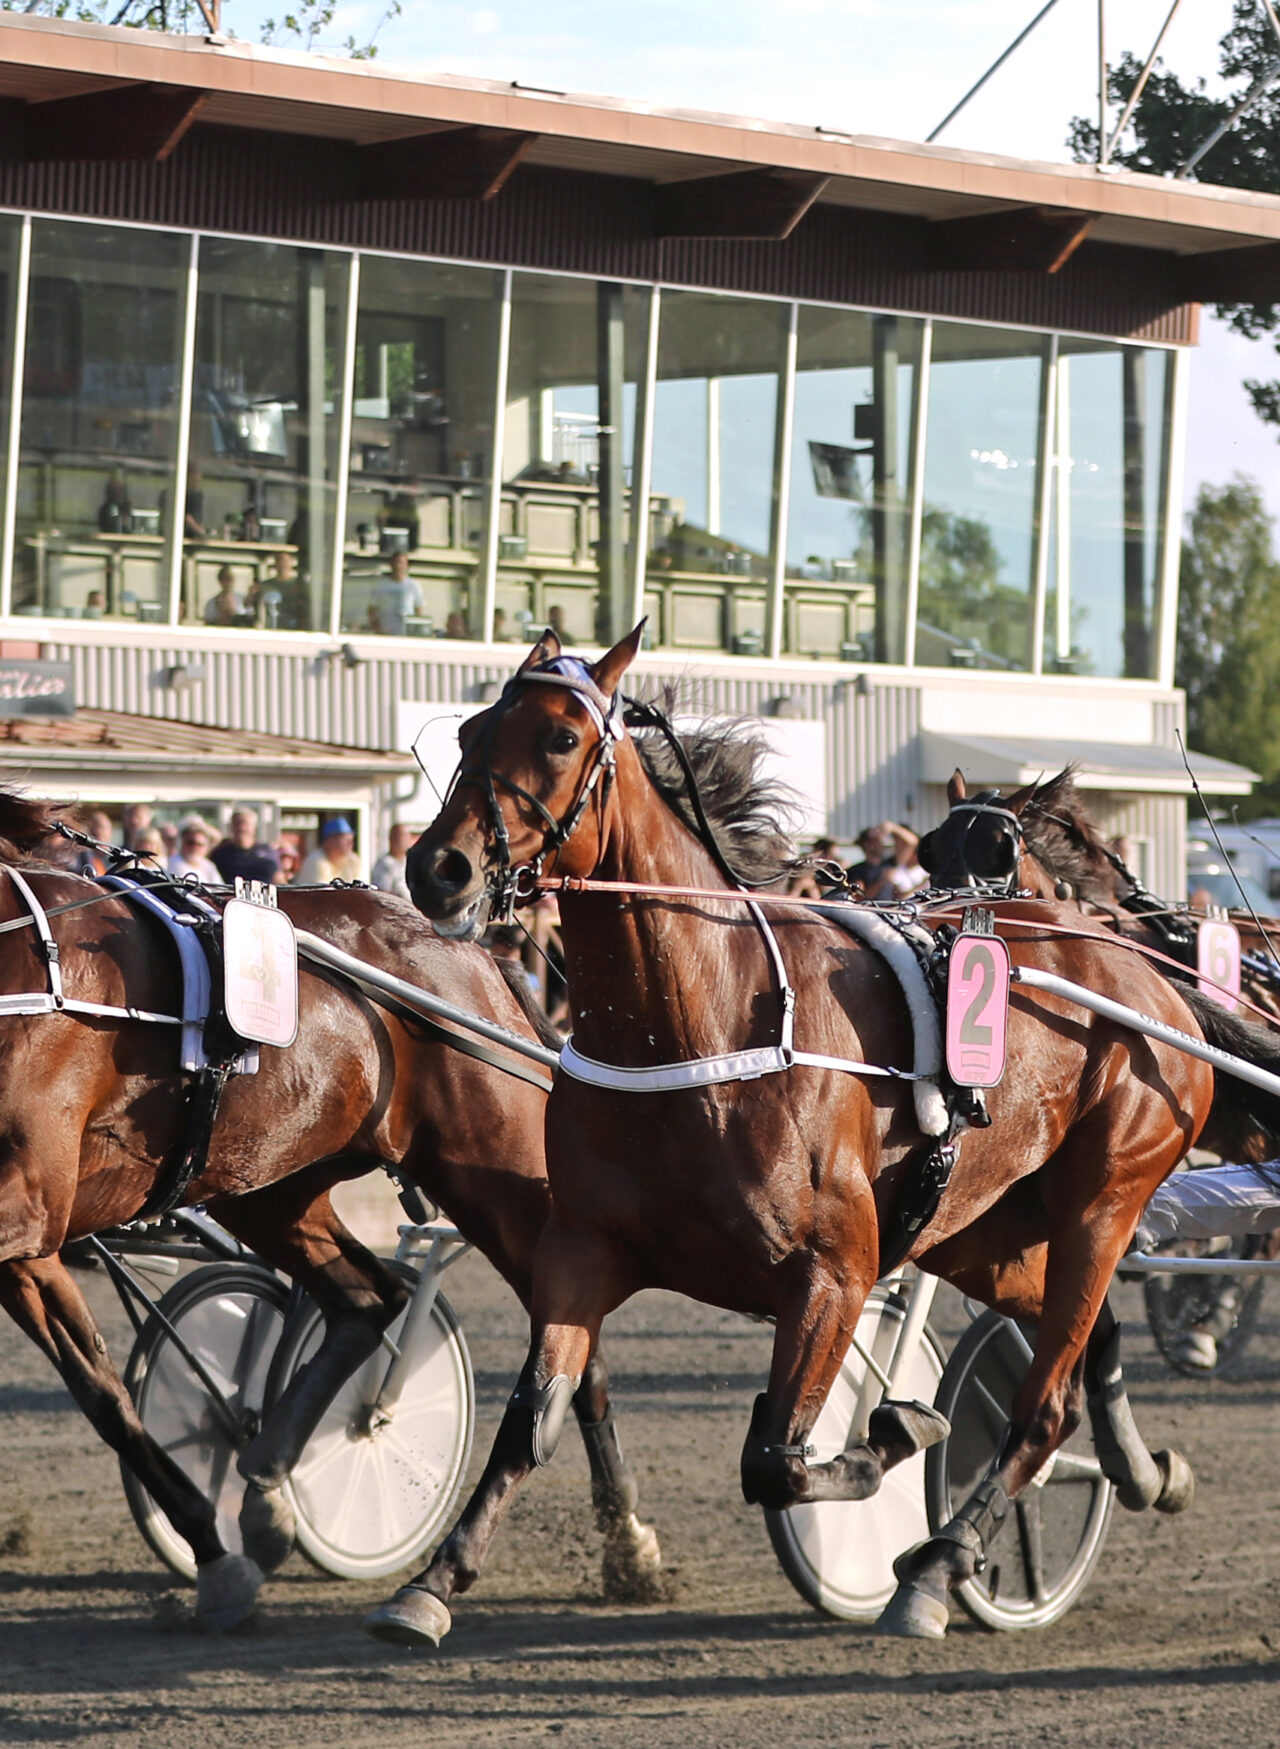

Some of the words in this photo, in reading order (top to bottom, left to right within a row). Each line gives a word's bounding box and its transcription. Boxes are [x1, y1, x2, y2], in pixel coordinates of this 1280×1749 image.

[239, 913, 281, 1003] 4
[959, 944, 995, 1046] 2
[1209, 927, 1231, 986] 6
